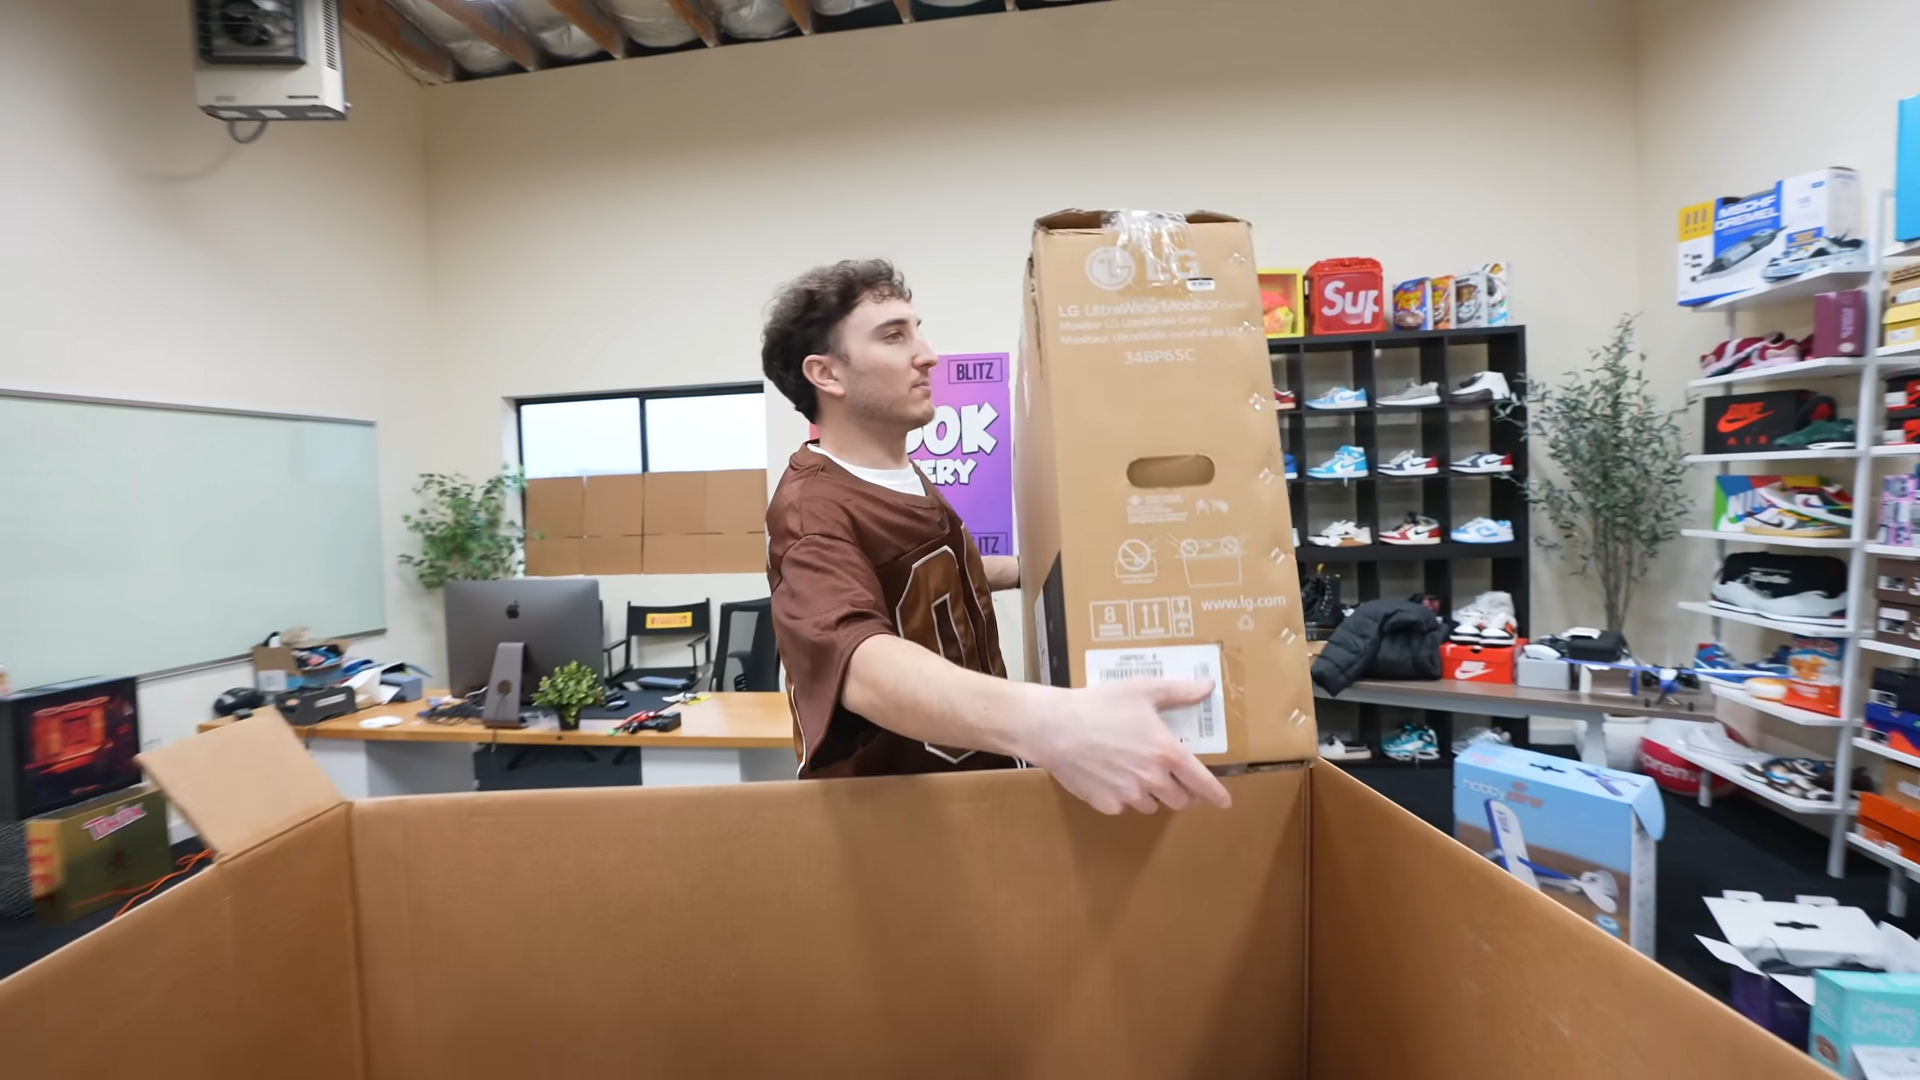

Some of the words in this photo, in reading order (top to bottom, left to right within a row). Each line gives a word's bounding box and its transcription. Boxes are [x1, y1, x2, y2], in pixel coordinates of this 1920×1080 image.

[1146, 249, 1200, 281] LG
[1058, 304, 1080, 317] LG
[956, 362, 995, 381] BLITZ
[914, 458, 977, 486] ERY
[972, 536, 999, 554] ITZ
[1200, 594, 1286, 612] www.lg.com
